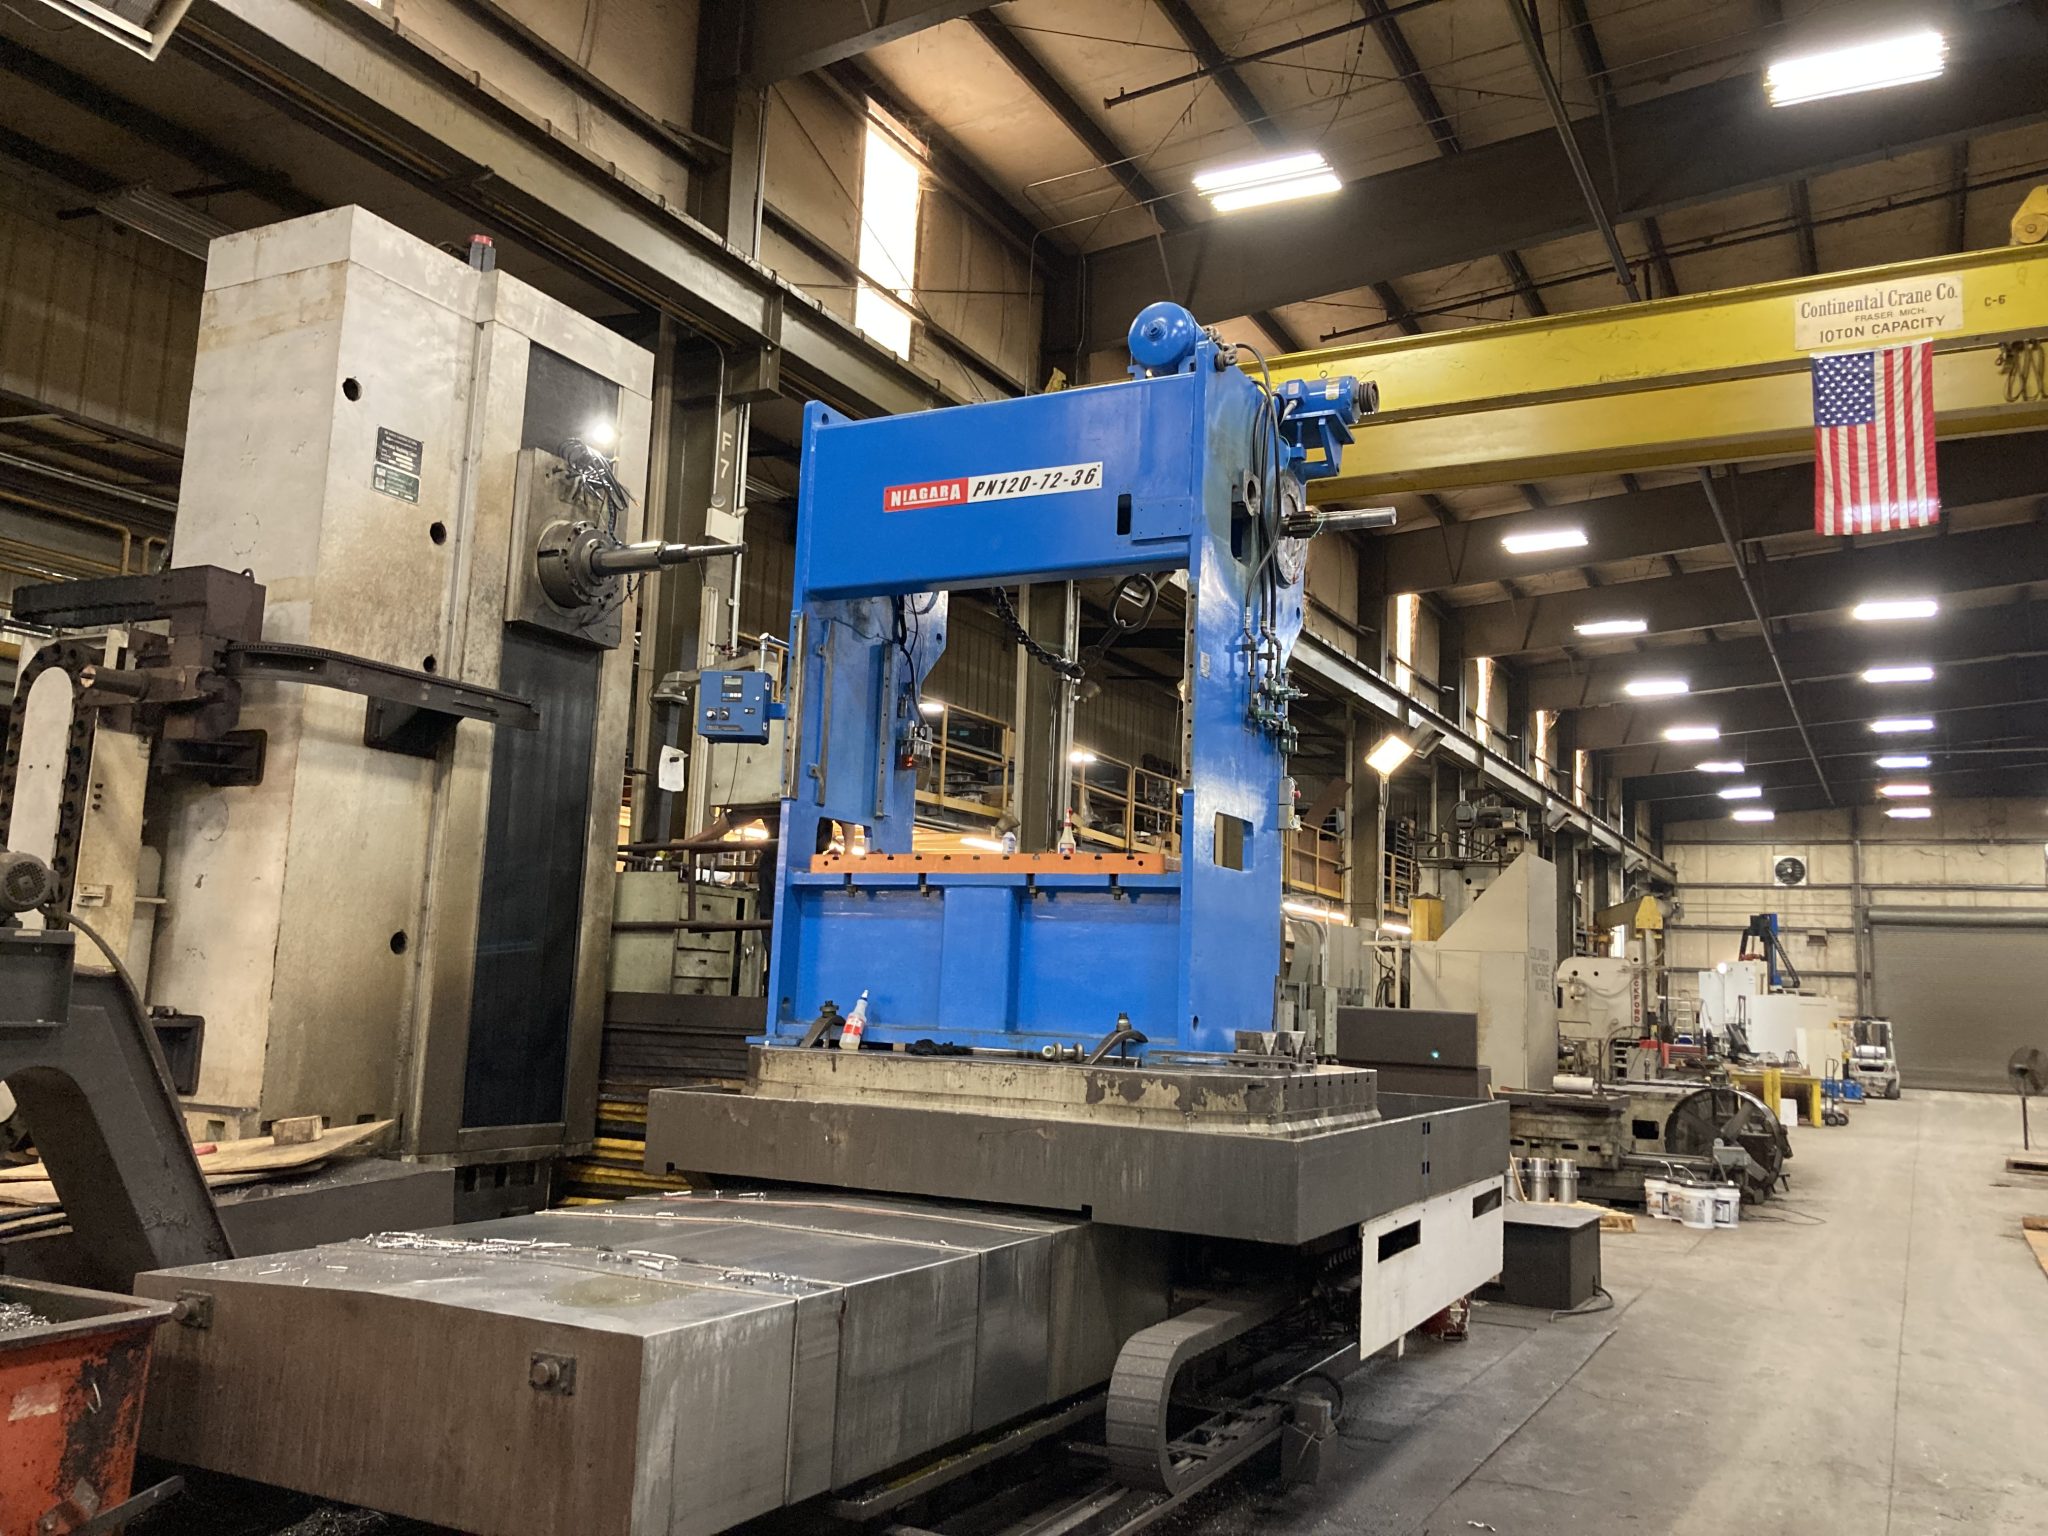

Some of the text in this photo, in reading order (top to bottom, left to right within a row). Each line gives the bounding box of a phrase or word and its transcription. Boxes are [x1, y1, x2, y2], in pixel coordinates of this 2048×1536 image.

[1801, 282, 1958, 319] Continental Crane Co.
[1855, 307, 1927, 322] FRASER MICH.
[1871, 315, 1946, 335] CAPACITY
[890, 467, 1097, 507] NIAGARA PN120-72-36
